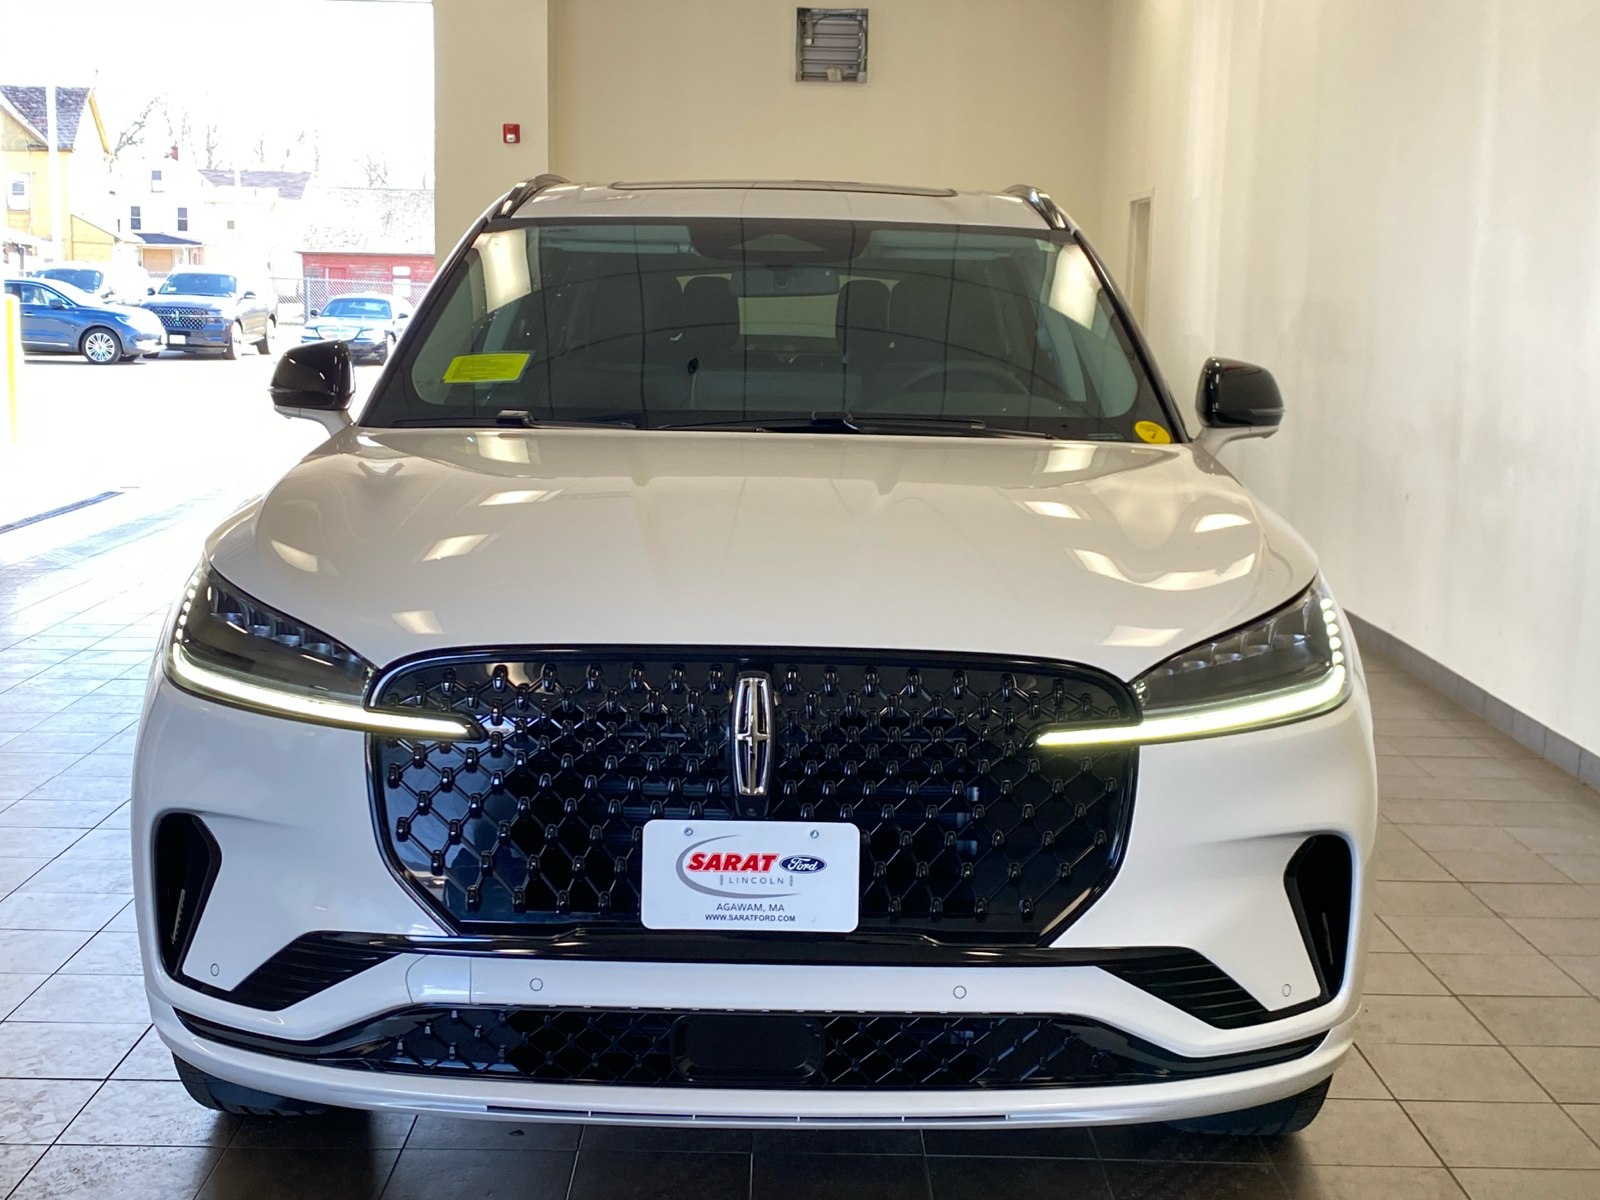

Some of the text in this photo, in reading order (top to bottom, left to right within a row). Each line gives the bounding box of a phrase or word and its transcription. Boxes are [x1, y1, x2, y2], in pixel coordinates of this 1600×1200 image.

[686, 852, 818, 872] SARAT Ford
[728, 876, 784, 885] LINCOLN
[716, 903, 785, 912] AGAWAM, MA
[705, 914, 796, 922] WWW.SARATFORD.COM
